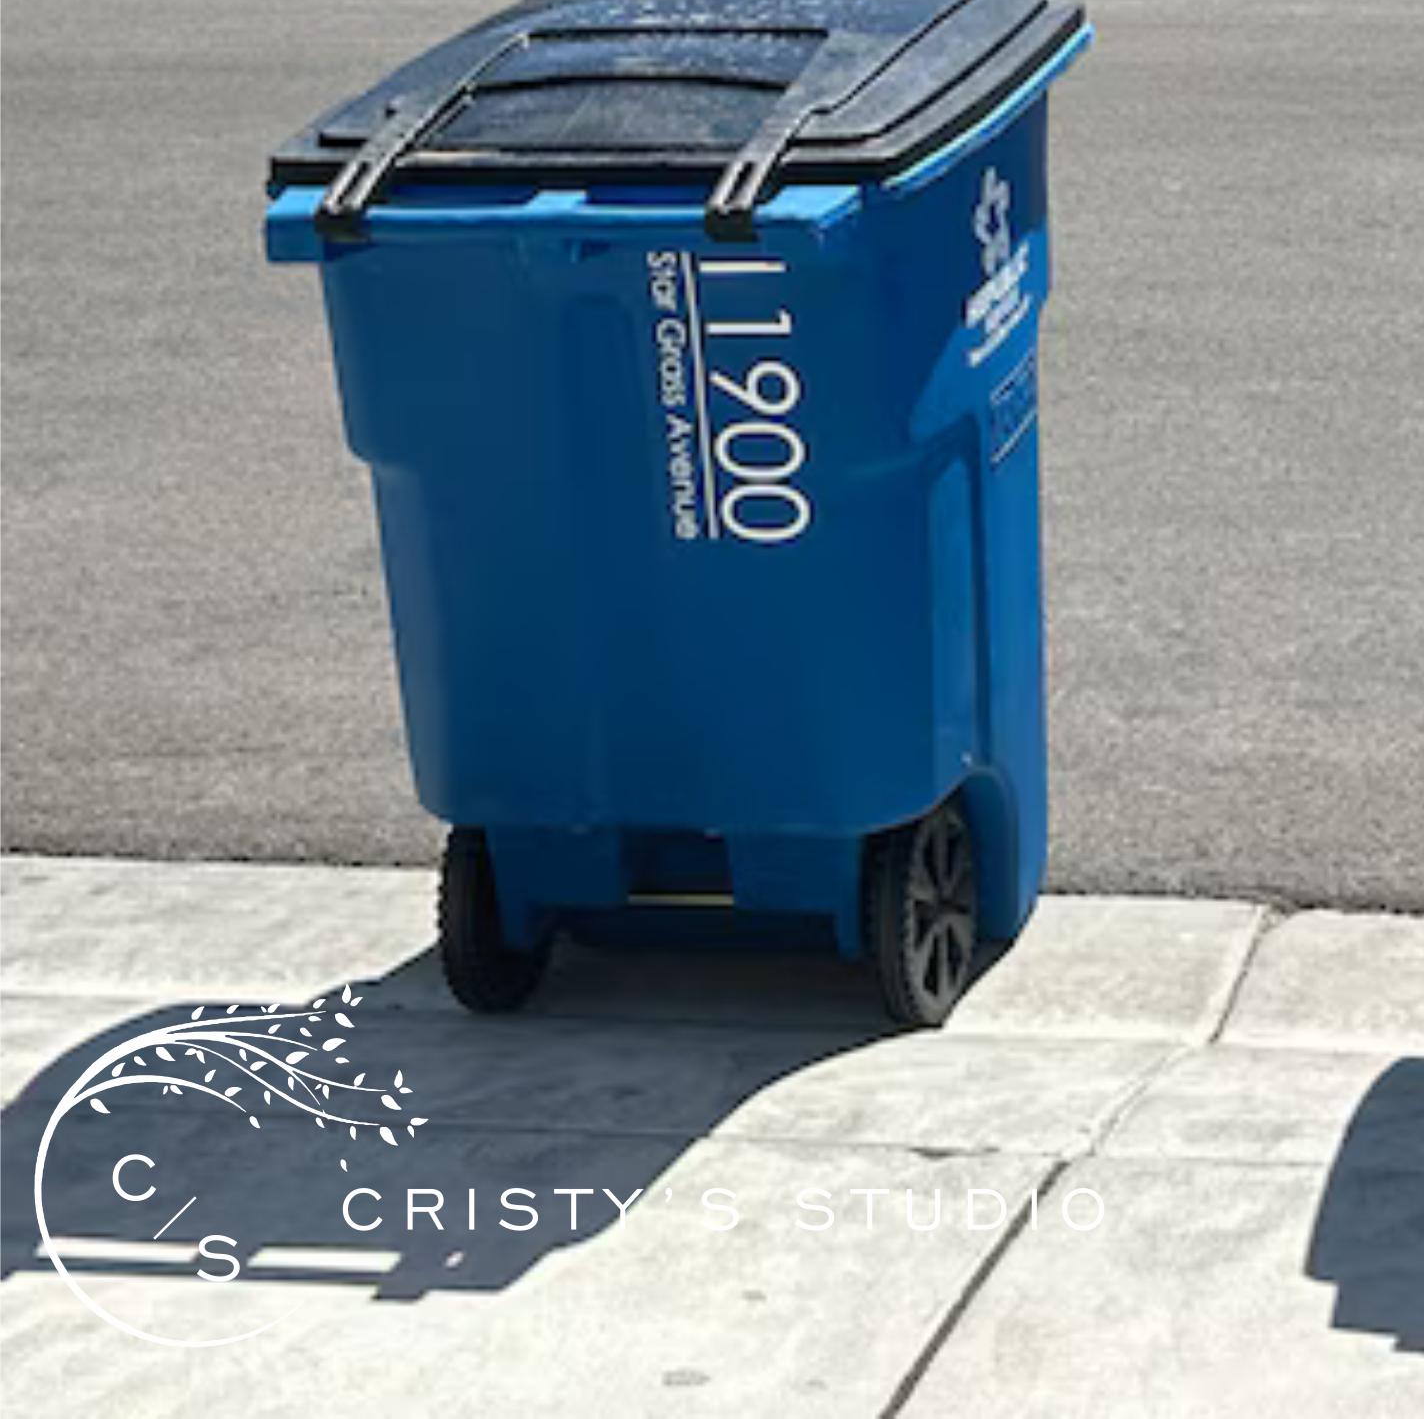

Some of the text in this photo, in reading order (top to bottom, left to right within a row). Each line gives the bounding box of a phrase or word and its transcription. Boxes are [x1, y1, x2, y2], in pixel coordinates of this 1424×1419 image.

[647, 251, 697, 539] Star Grass Avenue
[699, 259, 810, 541] 11900
